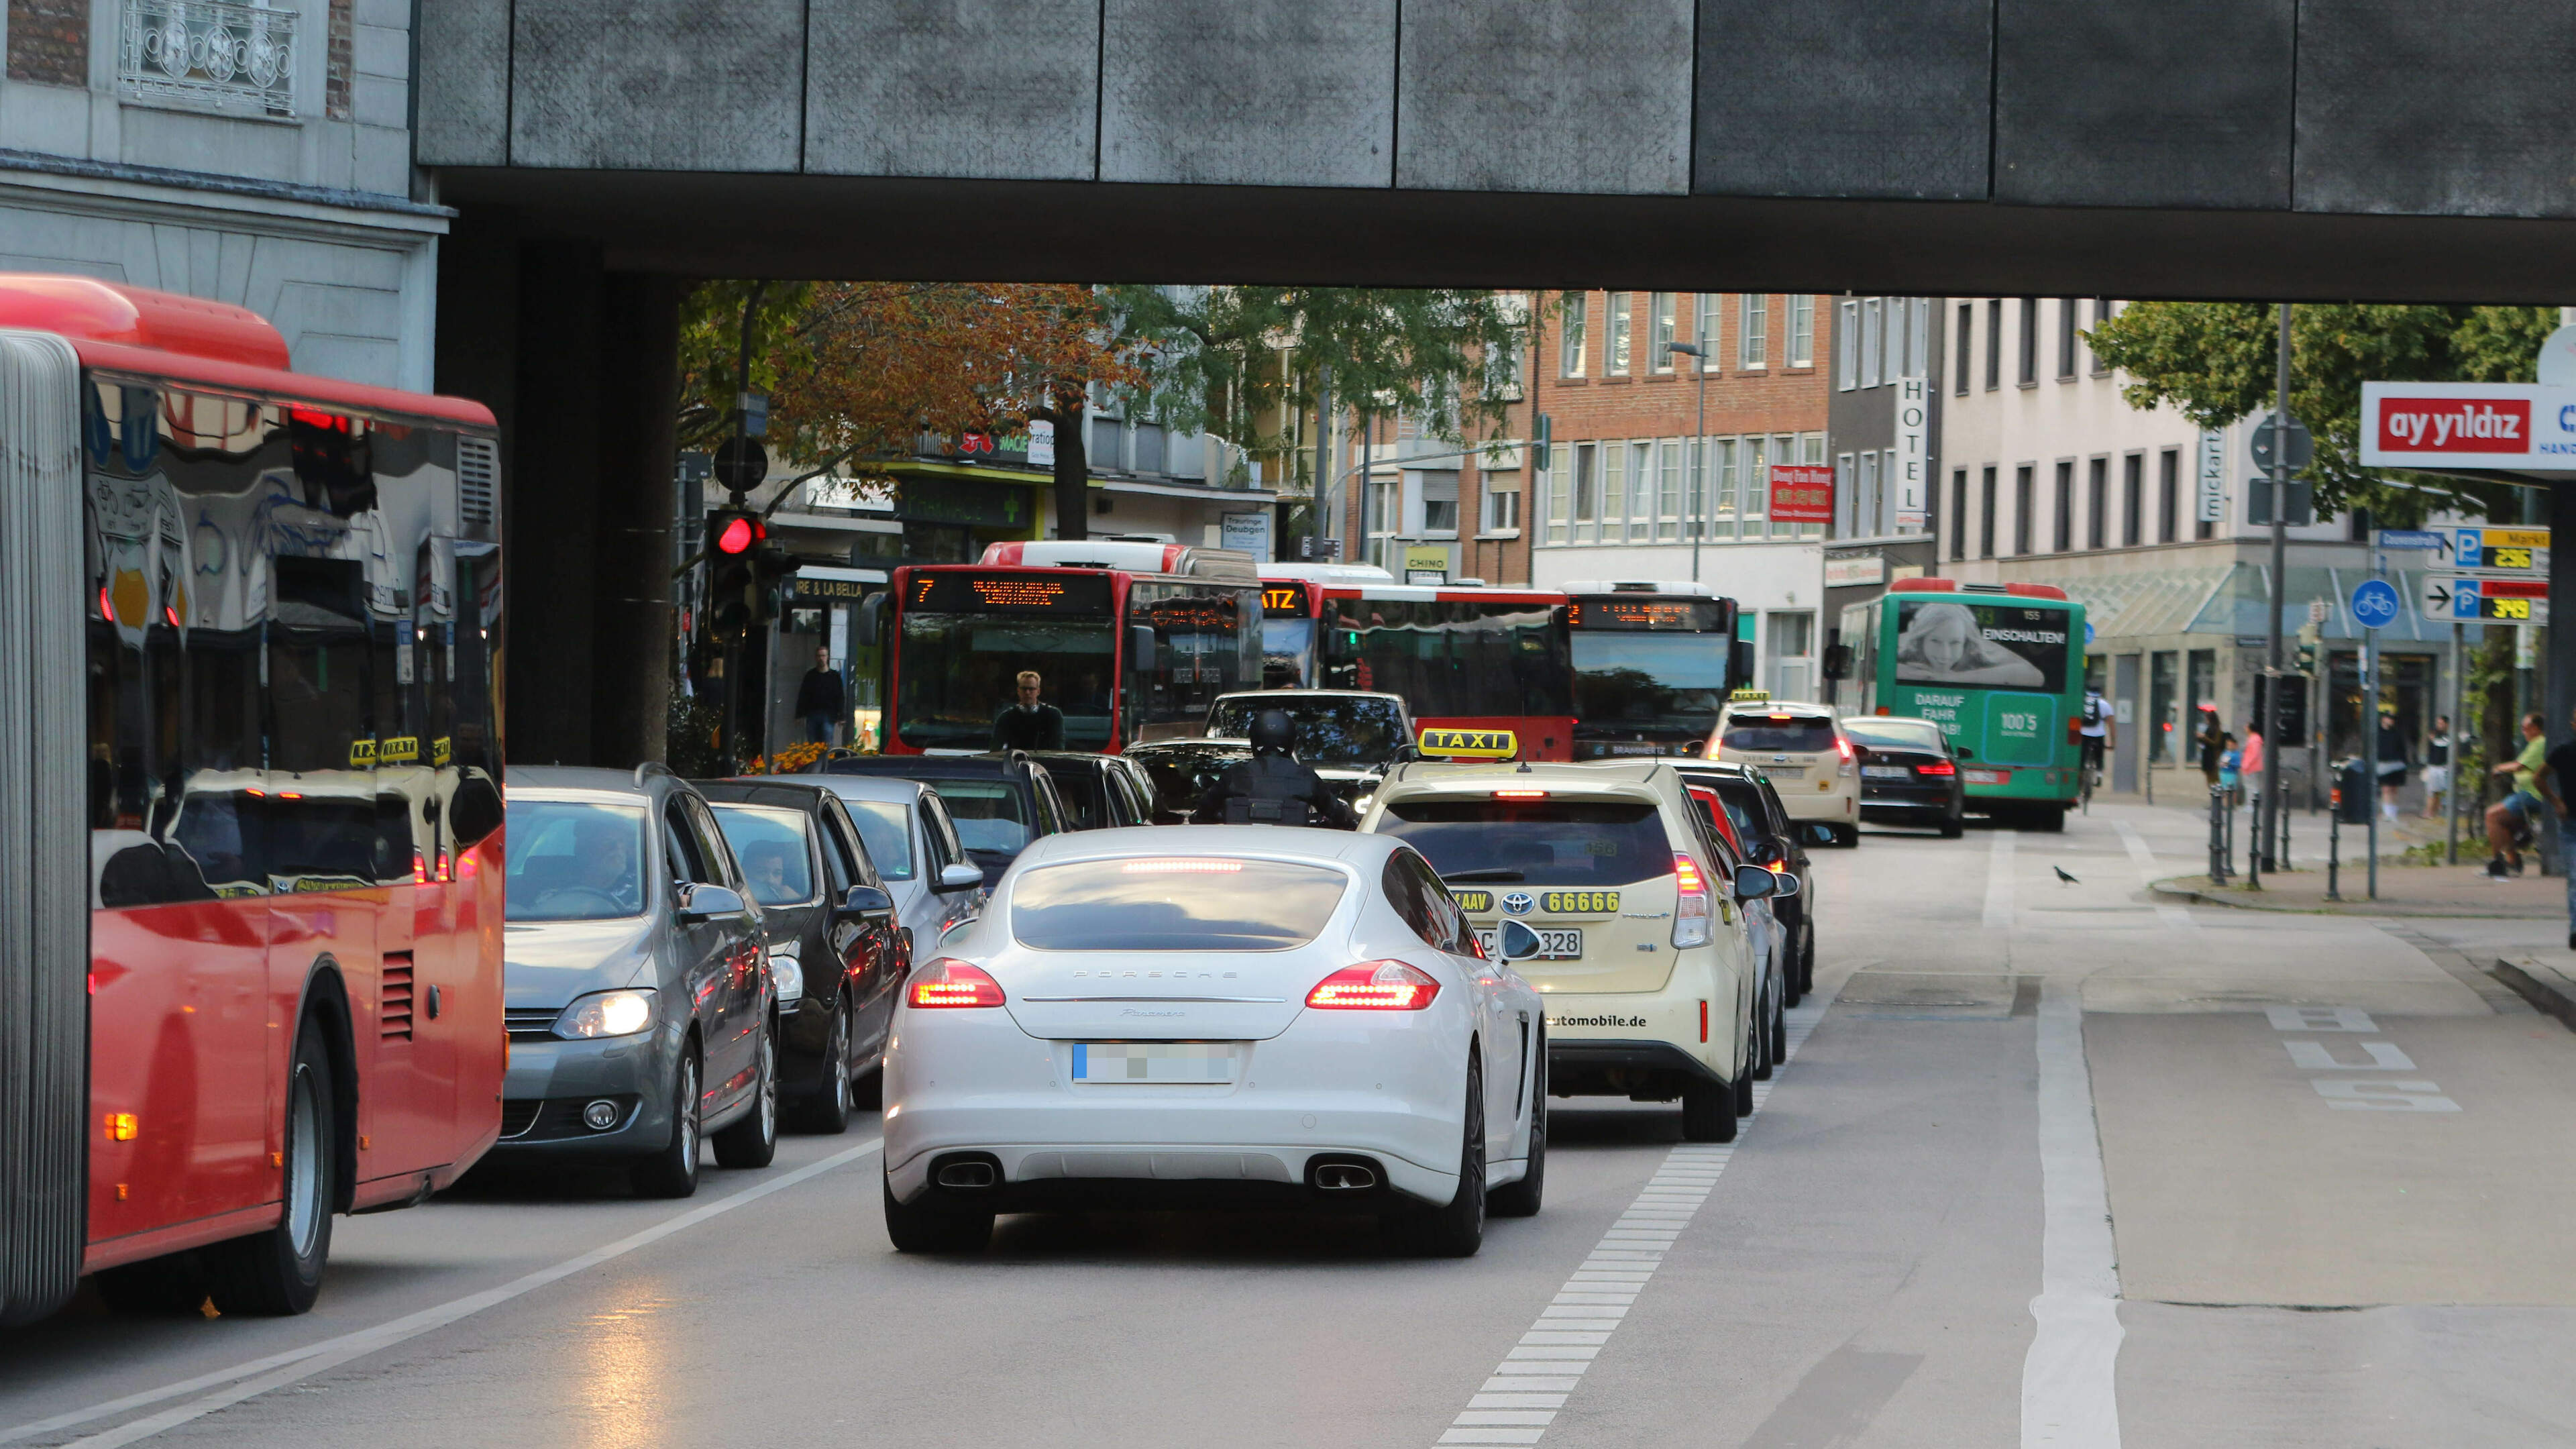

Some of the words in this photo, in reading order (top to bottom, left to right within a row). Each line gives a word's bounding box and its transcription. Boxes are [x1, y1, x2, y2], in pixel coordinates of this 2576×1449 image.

[2389, 413, 2428, 446] ay
[1904, 382, 1923, 508] HOTEL
[1226, 525, 1265, 535] Deubgen
[1409, 559, 1444, 568] CHINO
[796, 580, 810, 594] RE
[814, 581, 820, 596] &
[823, 582, 835, 596] LA
[836, 583, 862, 598] BELLA
[918, 579, 934, 602] 7
[1982, 628, 2065, 645] EINSCHALTEN!
[1915, 693, 1965, 708] DARAUF
[1921, 708, 1956, 722] FAHR
[1435, 733, 1498, 748] TAXI
[1613, 745, 1666, 755] BRAMMERTZ
[1461, 894, 1487, 910] AAV
[1548, 892, 1619, 912] 66666
[1073, 970, 1238, 978] PORSCHE
[1120, 1008, 1185, 1017] Panamera
[2265, 1006, 2463, 1112] BUS
